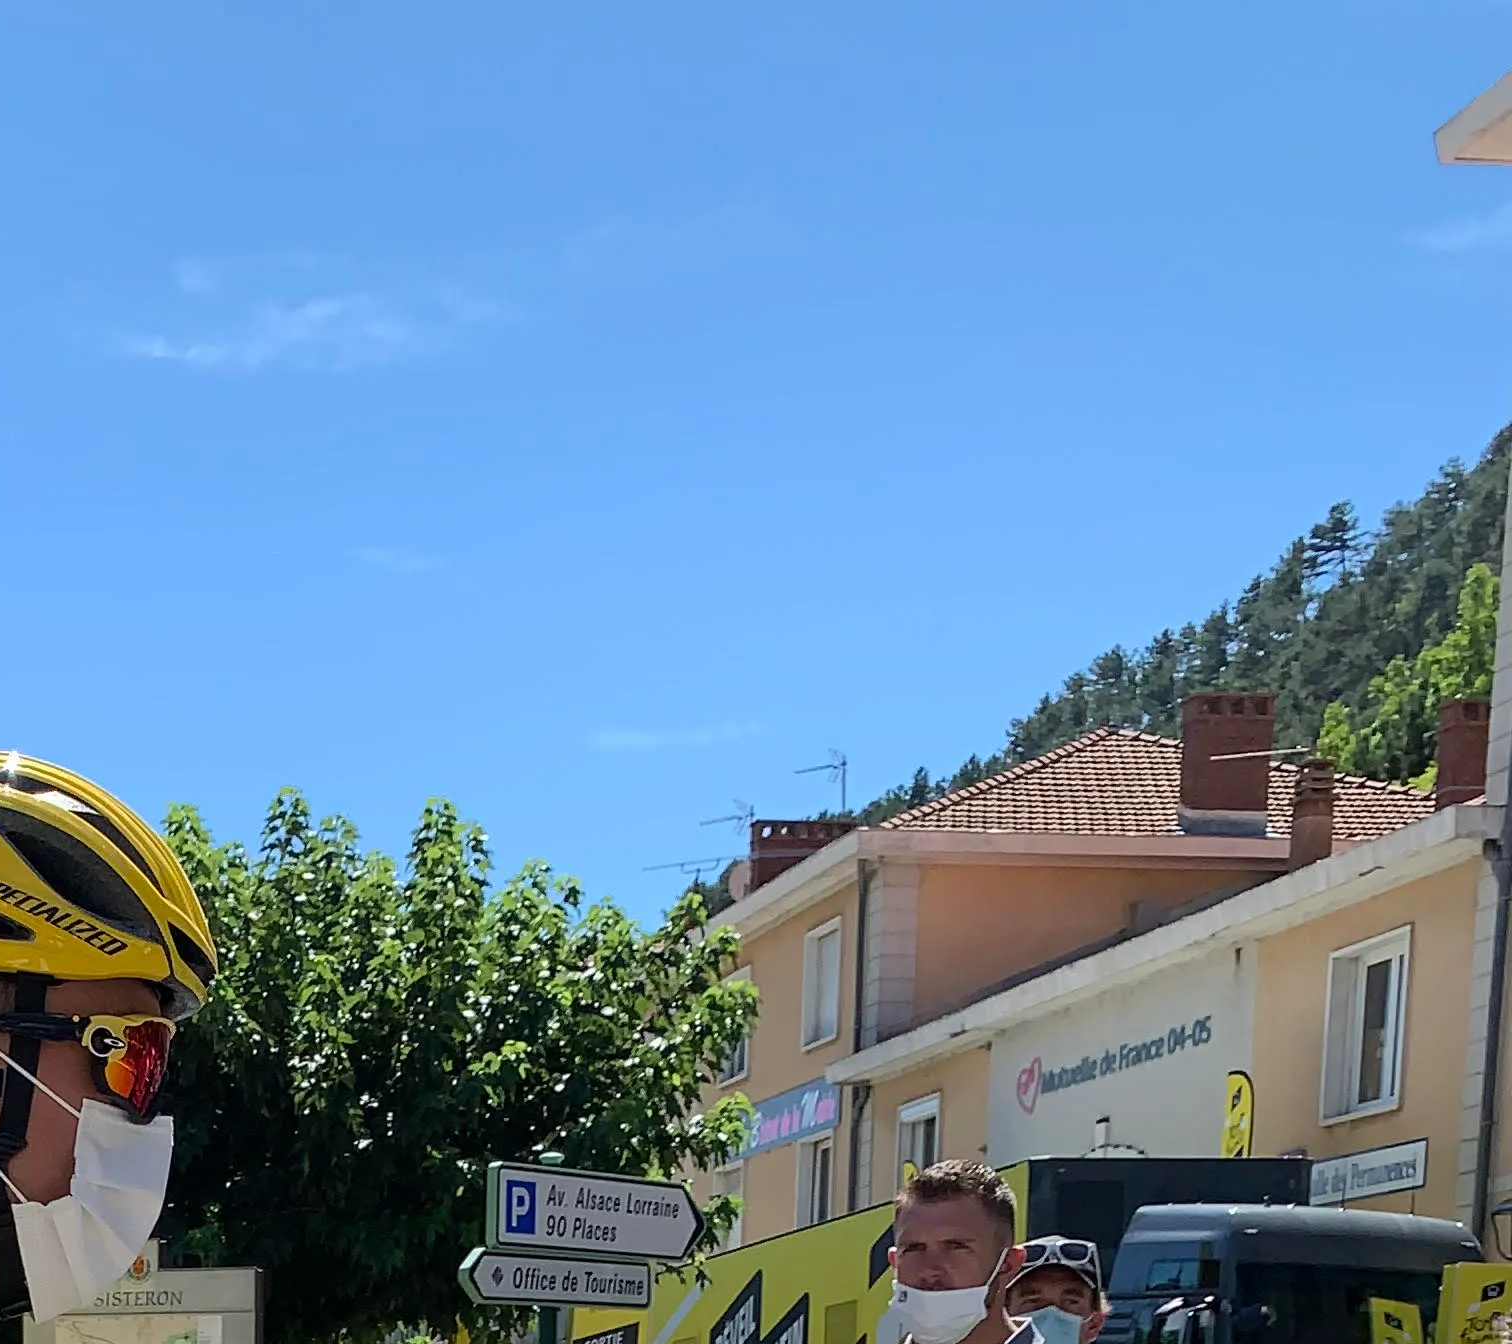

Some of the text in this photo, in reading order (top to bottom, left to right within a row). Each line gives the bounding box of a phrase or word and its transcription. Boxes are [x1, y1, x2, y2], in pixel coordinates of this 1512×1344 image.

[1119, 1036, 1164, 1071] France
[546, 1184, 568, 1208] Av.
[574, 1188, 621, 1213] Alsace
[626, 1192, 680, 1219] Lorraine
[545, 1215, 618, 1242] 90 Places
[513, 1266, 645, 1296] Office de Tourisme
[93, 1290, 183, 1307] SISTERON
